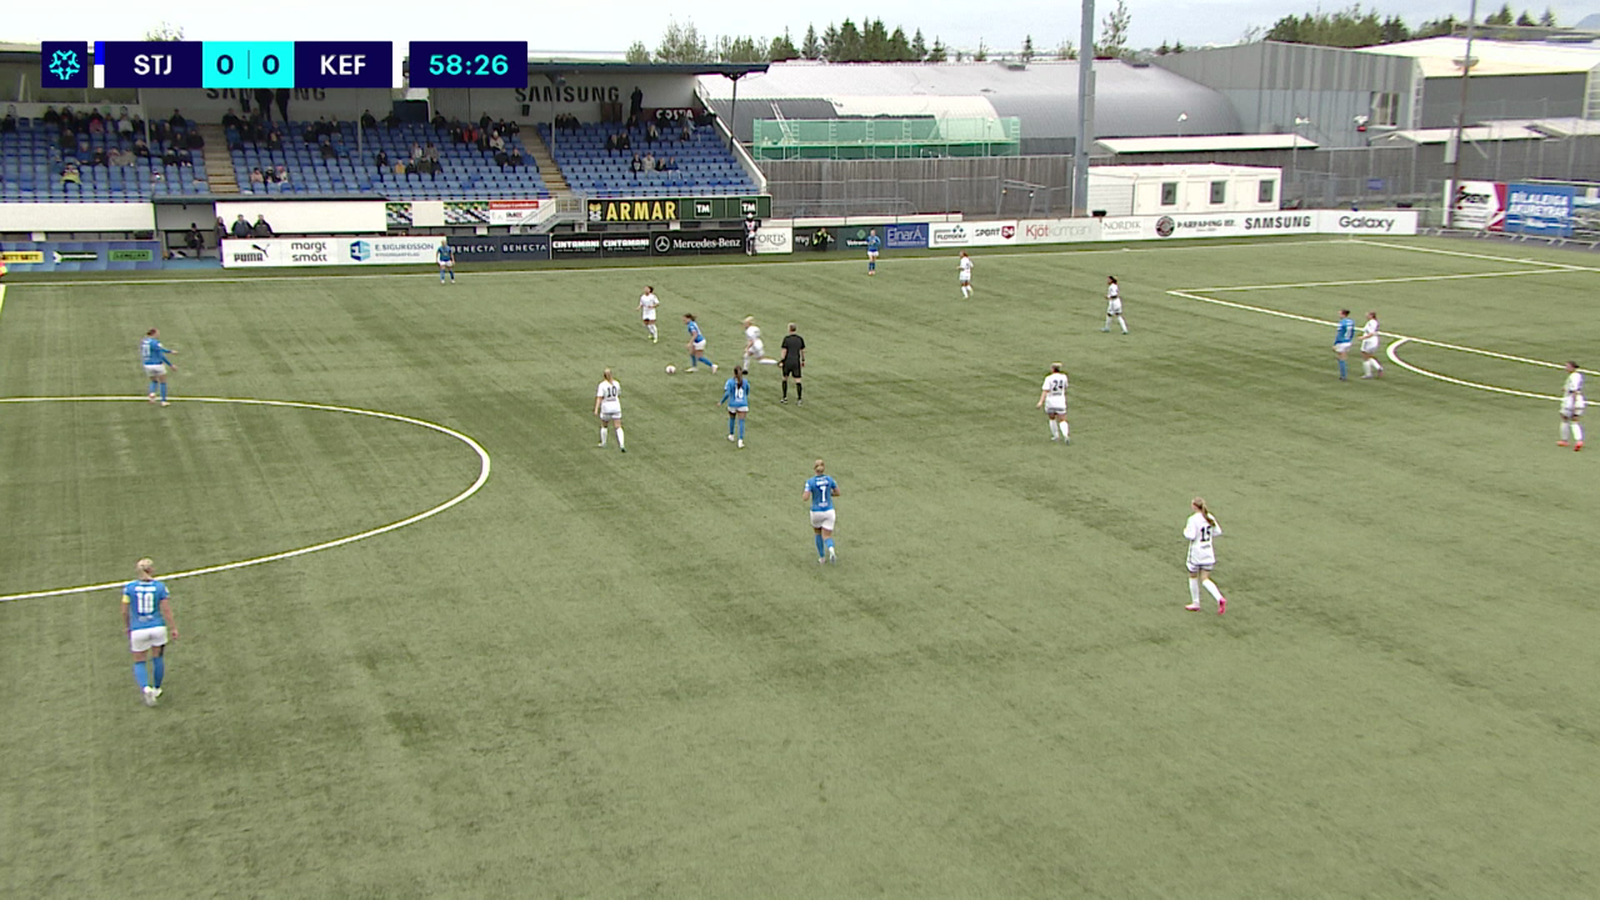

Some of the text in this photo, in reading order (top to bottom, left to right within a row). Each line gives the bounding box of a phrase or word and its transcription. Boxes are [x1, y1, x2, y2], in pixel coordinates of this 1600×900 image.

[514, 86, 620, 103] SAMSUNG
[606, 201, 677, 221] ARMAR
[696, 204, 710, 213] TM
[741, 203, 756, 212] TM
[1244, 215, 1312, 231] SAMSUNG
[1338, 215, 1395, 232] Galaxy
[672, 236, 742, 249] Mercedes-Benz
[234, 253, 264, 263] PUMA
[607, 386, 617, 397] 10
[1053, 380, 1064, 391] 24
[820, 485, 827, 502] 7
[1200, 526, 1211, 542] 15
[136, 592, 155, 613] 10
